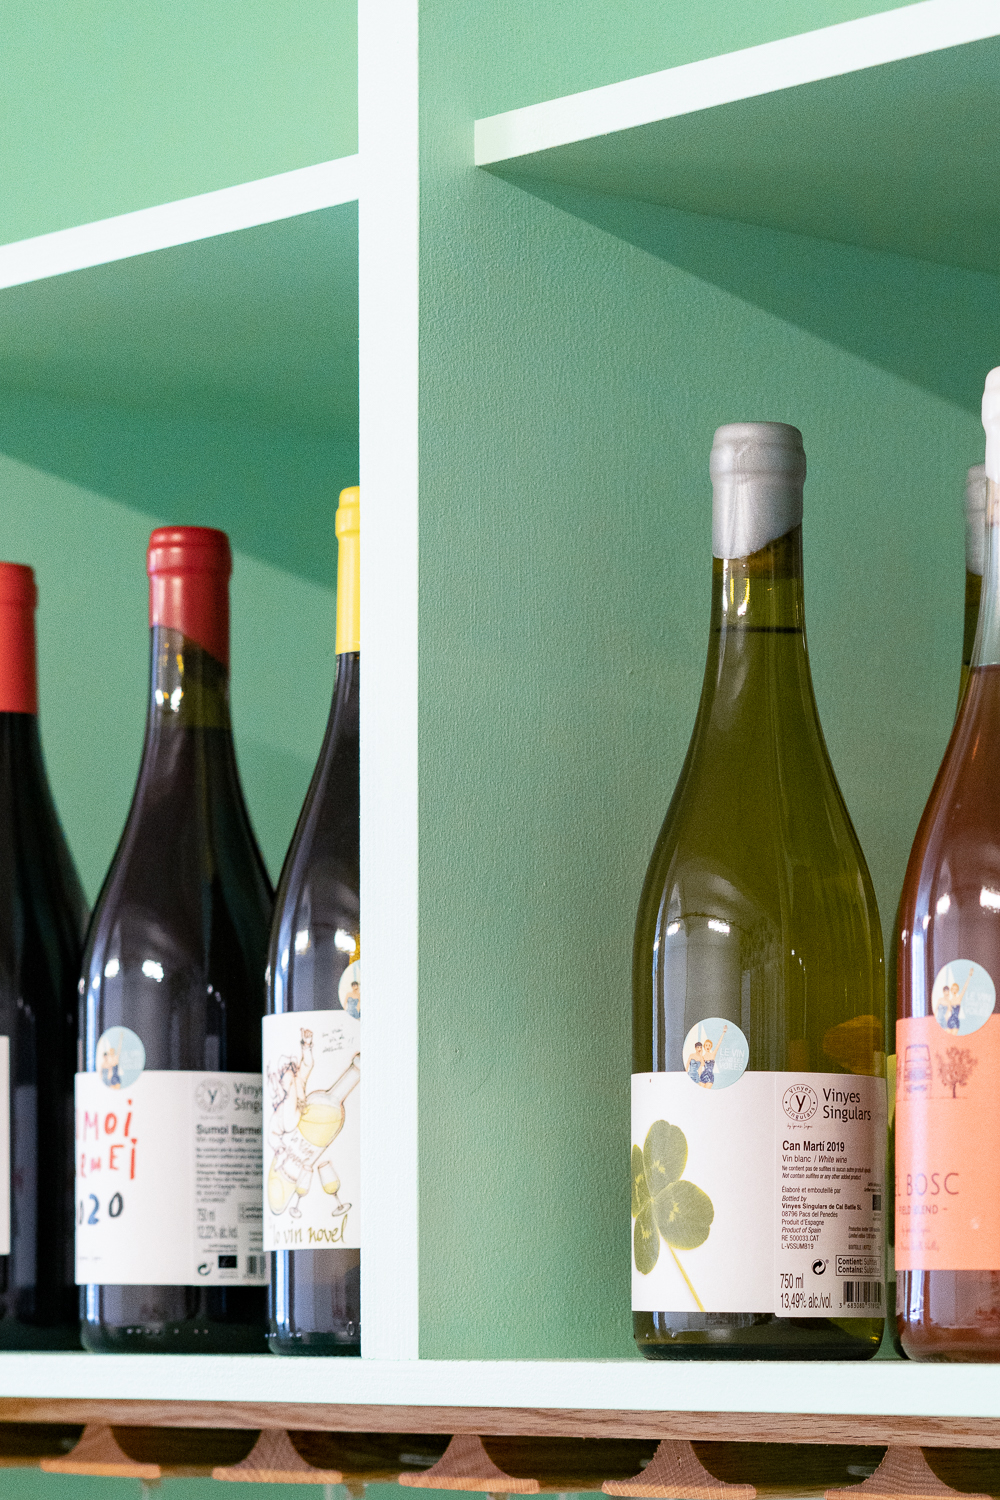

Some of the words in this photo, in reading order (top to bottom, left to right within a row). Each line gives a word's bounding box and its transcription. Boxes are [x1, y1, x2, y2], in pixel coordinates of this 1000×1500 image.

[720, 1048, 730, 1057] LE
[732, 1048, 745, 1058] VIN
[719, 1062, 744, 1071] VOILES
[823, 1088, 861, 1106] Vinyes
[823, 1105, 872, 1123] Singulars
[782, 1140, 801, 1151] Can
[803, 1140, 825, 1151] Martí
[826, 1141, 845, 1152] 2019
[782, 1154, 793, 1162] Vin
[794, 1154, 812, 1163] blanc
[818, 1155, 835, 1163] White
[835, 1156, 848, 1164] wine
[781, 1185, 801, 1193] Élaboré
[906, 1172, 959, 1196] BOSC
[802, 1203, 828, 1211] Singulars
[283, 1220, 303, 1244] vin
[307, 1214, 348, 1244] novel
[838, 1257, 863, 1265] Contient:
[780, 1273, 793, 1289] 750
[795, 1273, 804, 1289] ml
[780, 1292, 807, 1310] 13,49%
